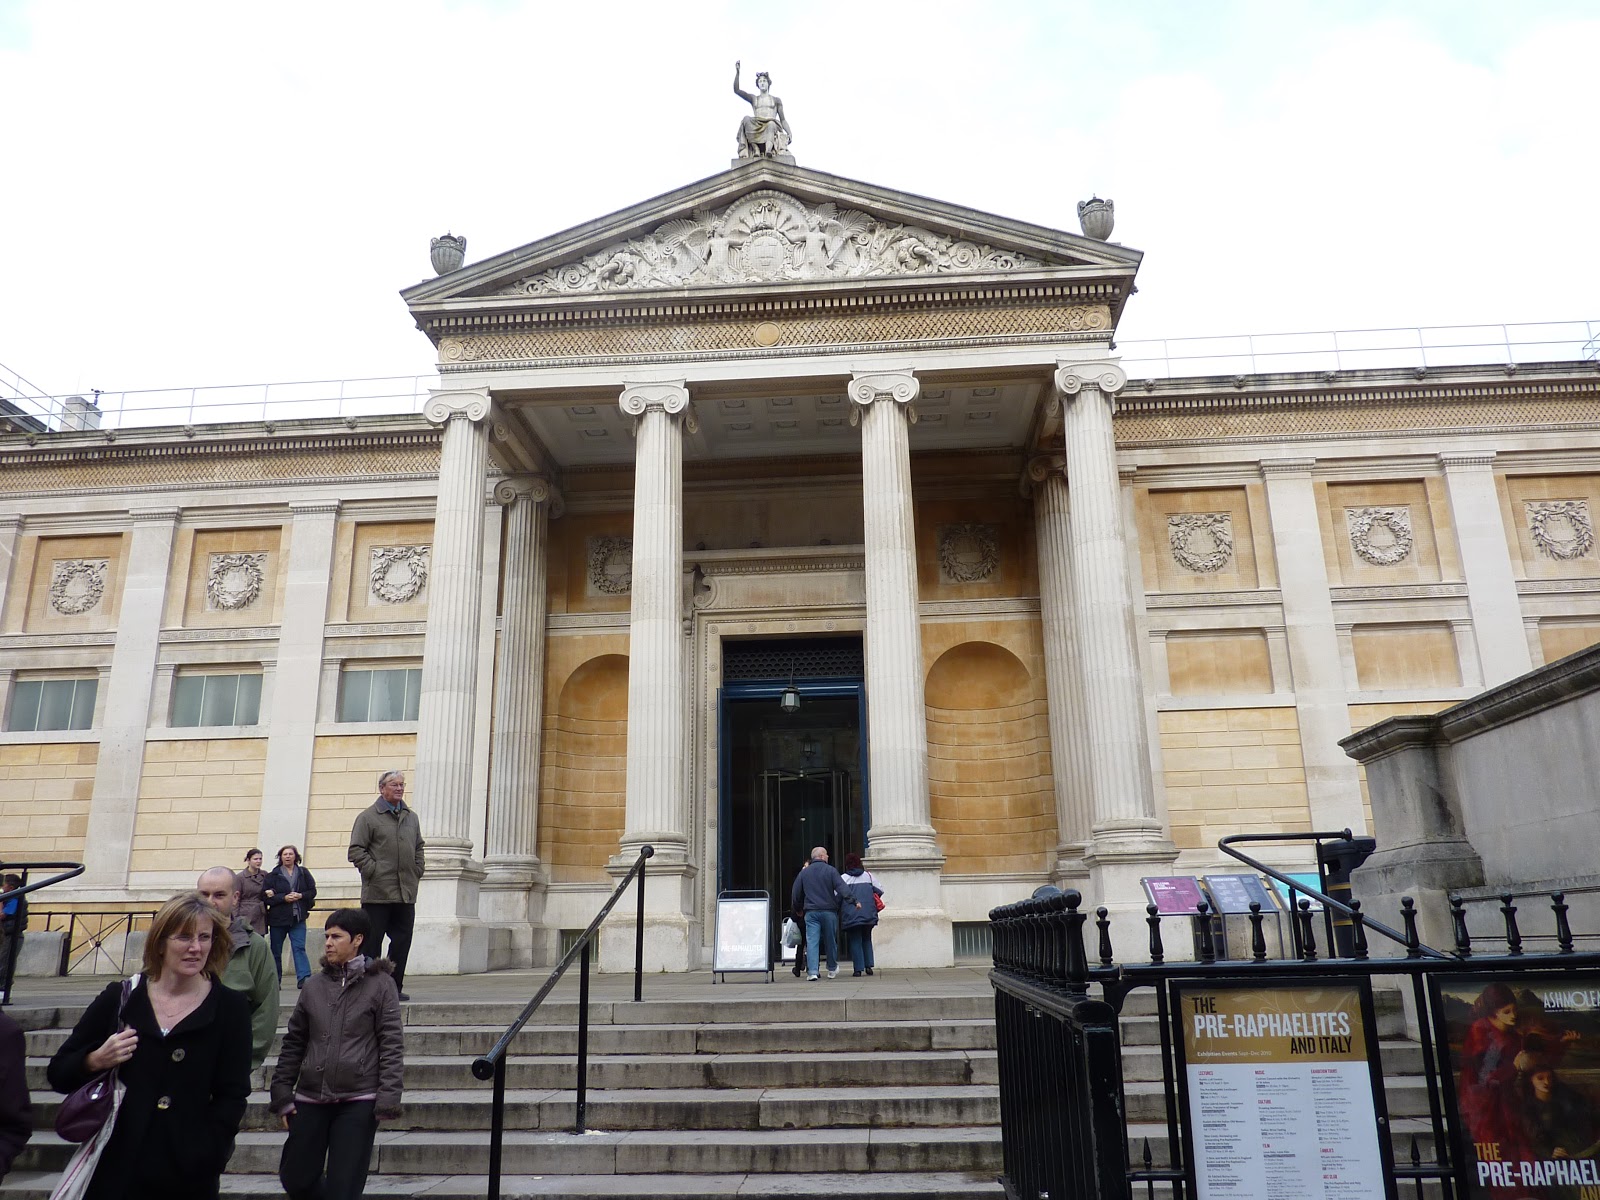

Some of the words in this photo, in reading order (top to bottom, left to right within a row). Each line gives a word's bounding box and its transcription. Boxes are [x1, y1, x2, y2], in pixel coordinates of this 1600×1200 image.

[1192, 997, 1217, 1013] THE
[1194, 1012, 1351, 1038] PRE-RAPHAELITES
[1291, 1037, 1316, 1054] AND
[1319, 1036, 1352, 1053] ITALY
[1474, 1143, 1502, 1160] THE
[1580, 1186, 1600, 1200] AN
